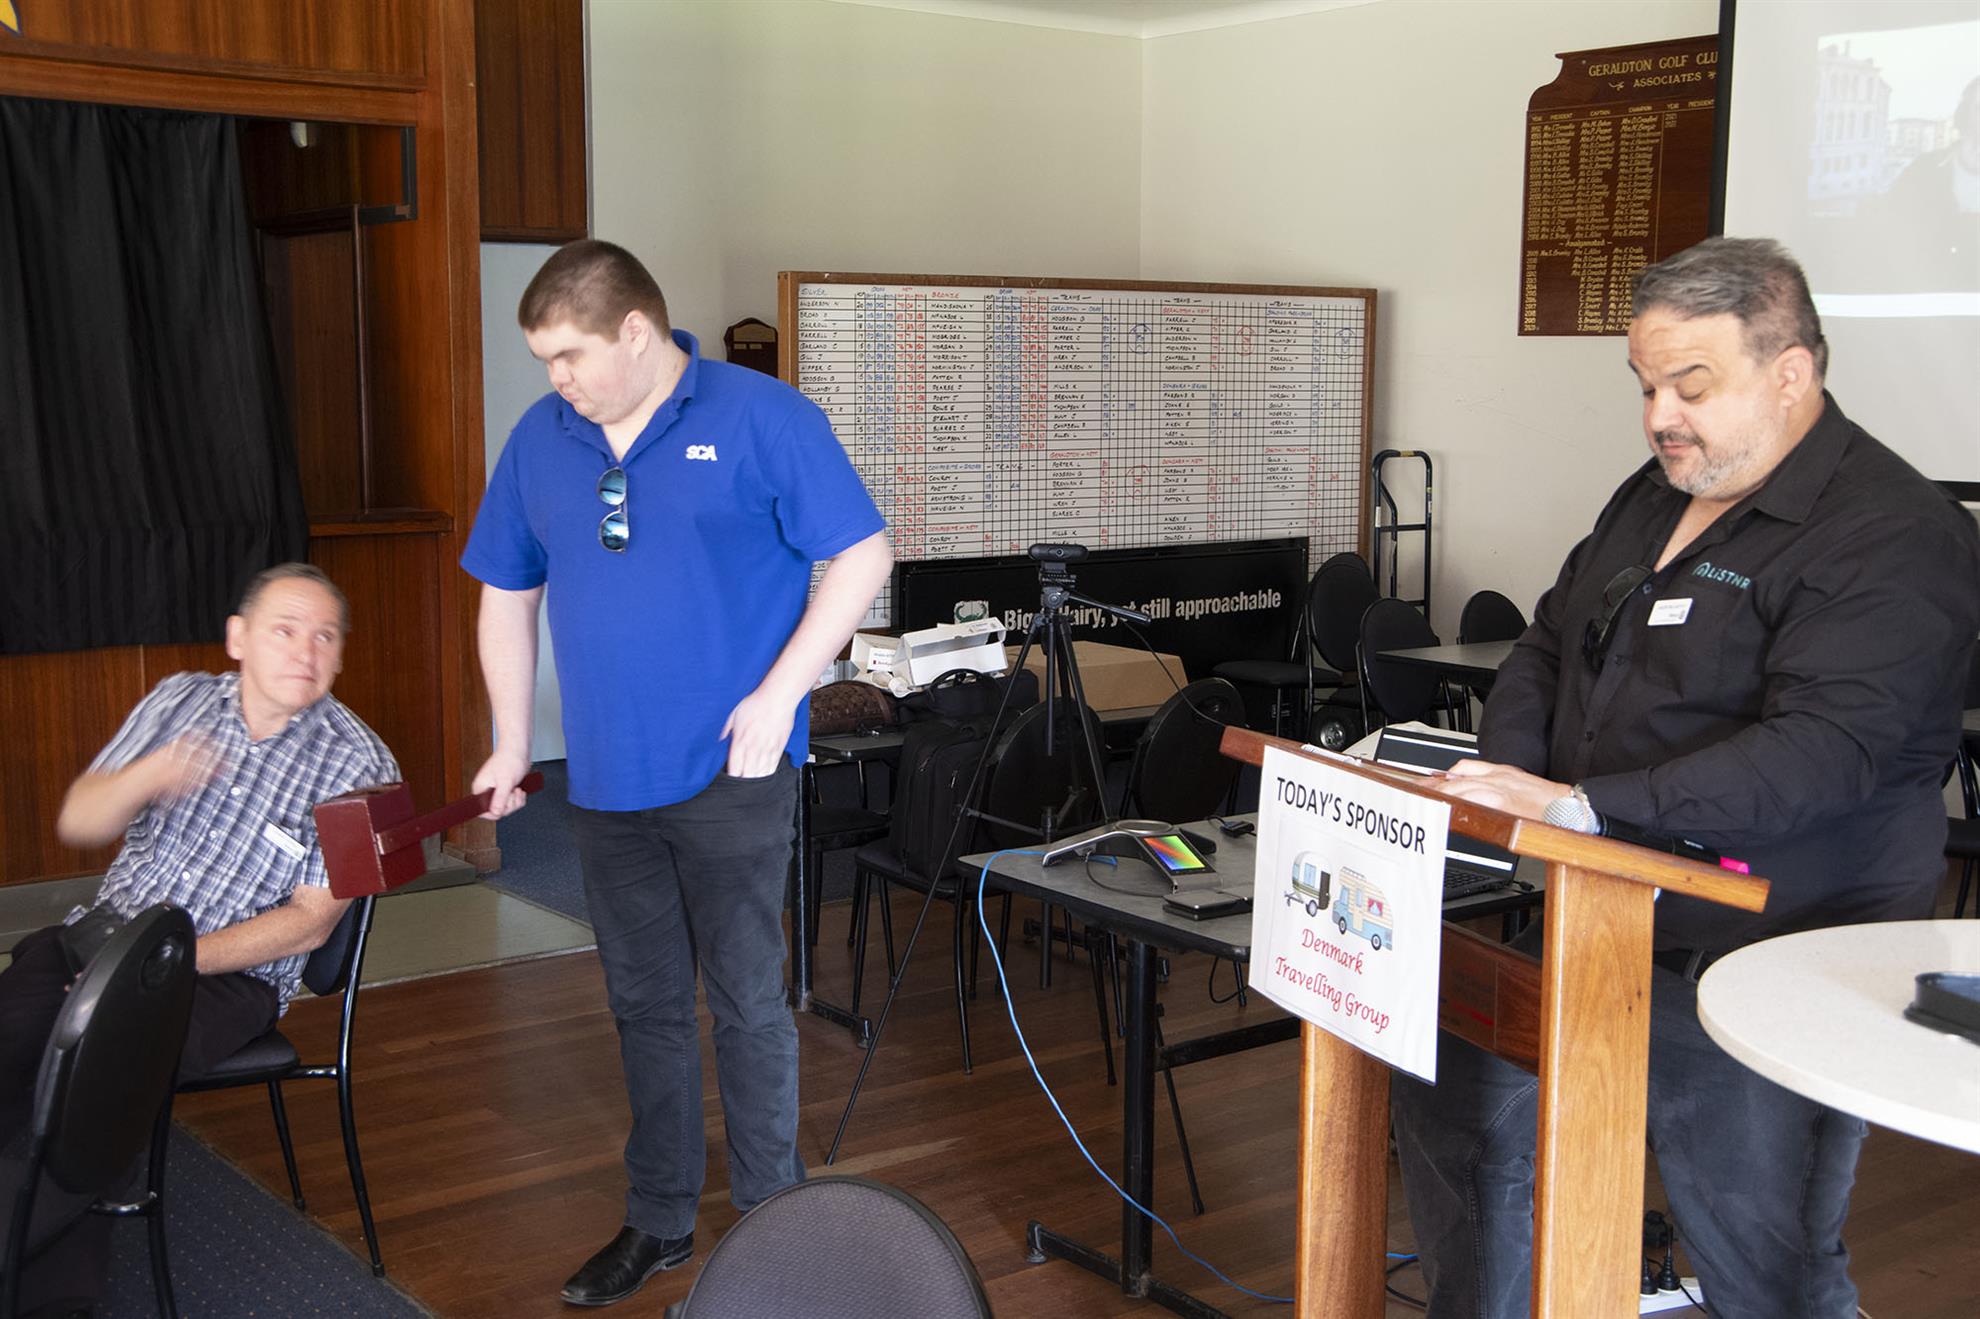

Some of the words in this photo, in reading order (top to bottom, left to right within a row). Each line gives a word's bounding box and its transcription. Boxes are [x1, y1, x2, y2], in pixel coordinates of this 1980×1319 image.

[1588, 60, 1652, 77] GERALDTON
[1659, 55, 1688, 69] GOLF
[1696, 51, 1718, 65] CLU
[1633, 72, 1702, 88] ASSOCIATES
[686, 444, 718, 461] SCA
[1141, 597, 1170, 619] still
[1175, 588, 1281, 620] approachable
[1277, 777, 1342, 822] TODAY'S
[1345, 801, 1426, 855] SPONSOR
[1301, 928, 1365, 975] Denmark
[1275, 957, 1342, 1014] Travelling
[1344, 992, 1391, 1034] Group
